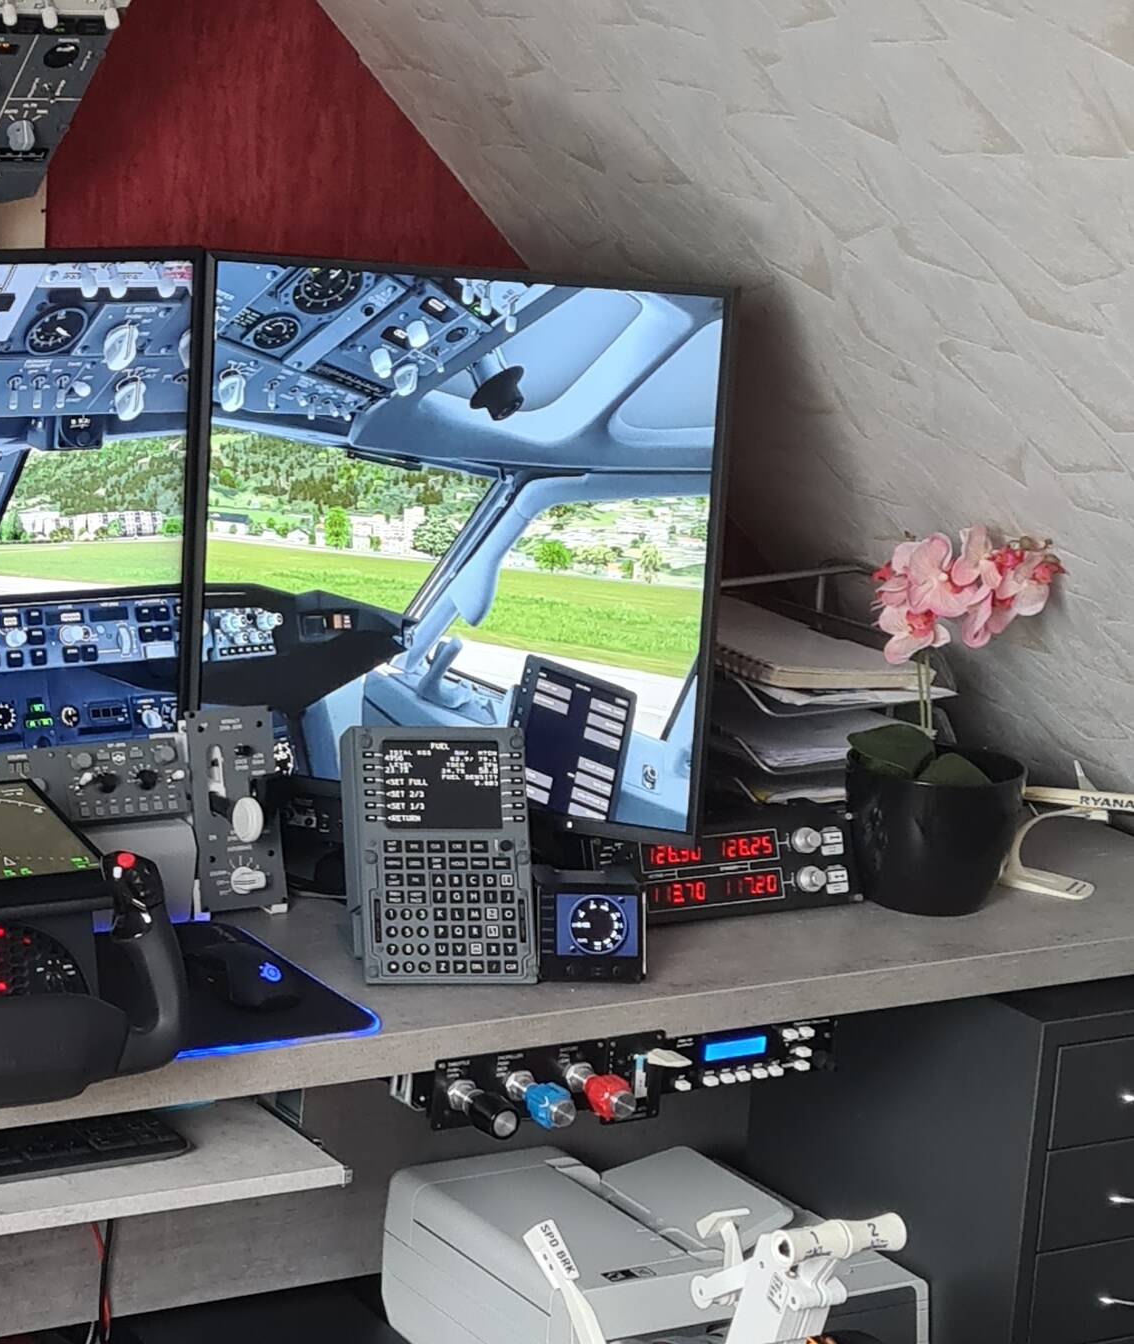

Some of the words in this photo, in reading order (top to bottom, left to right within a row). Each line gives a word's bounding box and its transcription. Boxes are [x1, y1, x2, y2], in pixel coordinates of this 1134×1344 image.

[430, 742, 450, 751] FUEL
[408, 778, 428, 786] FULL
[409, 790, 425, 798] 2/3
[410, 802, 425, 810] 1/3
[469, 876, 477, 884] C
[487, 876, 493, 884] D
[439, 945, 445, 953] U
[455, 945, 462, 953] V
[491, 945, 497, 953] X
[507, 945, 514, 953] Y
[867, 1223, 879, 1237] 2
[809, 1230, 820, 1244] 1
[540, 1223, 558, 1248] SPD
[556, 1247, 576, 1275] BRK
